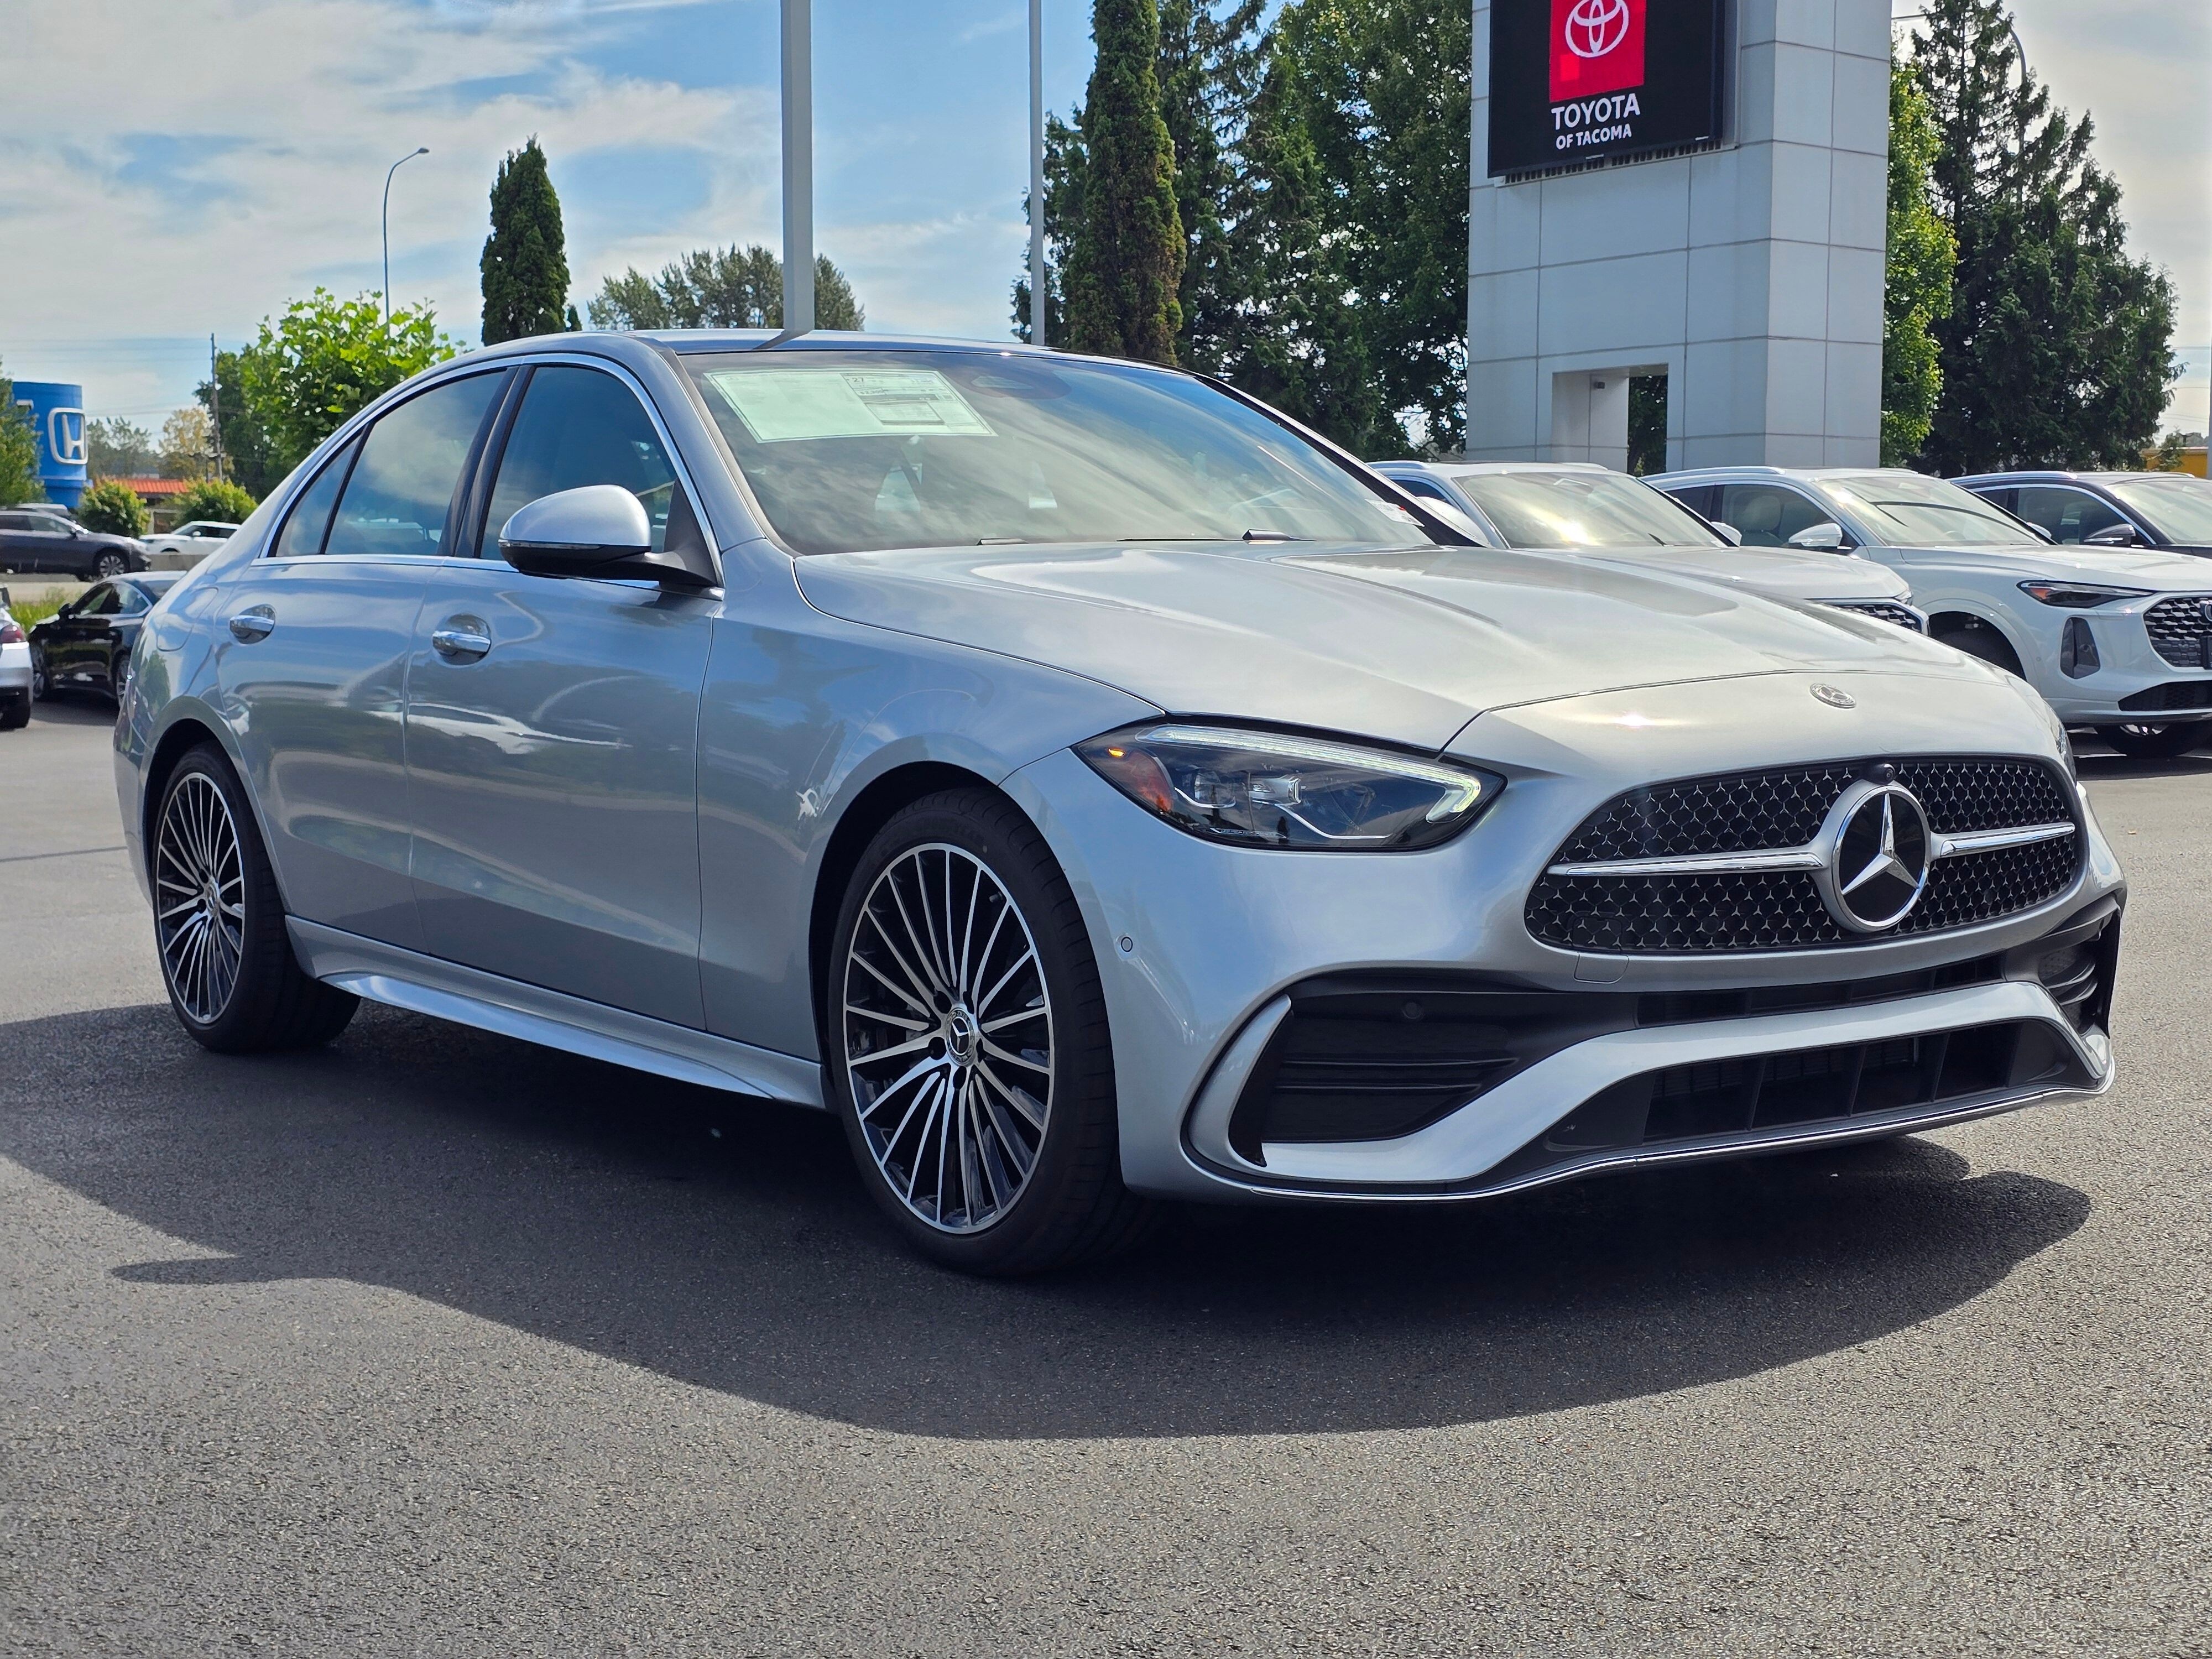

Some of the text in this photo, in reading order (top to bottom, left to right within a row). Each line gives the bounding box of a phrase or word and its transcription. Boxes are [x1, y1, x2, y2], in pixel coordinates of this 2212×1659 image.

[1551, 93, 1641, 130] TOYOTA
[1556, 123, 1632, 150] OF TACOMA
